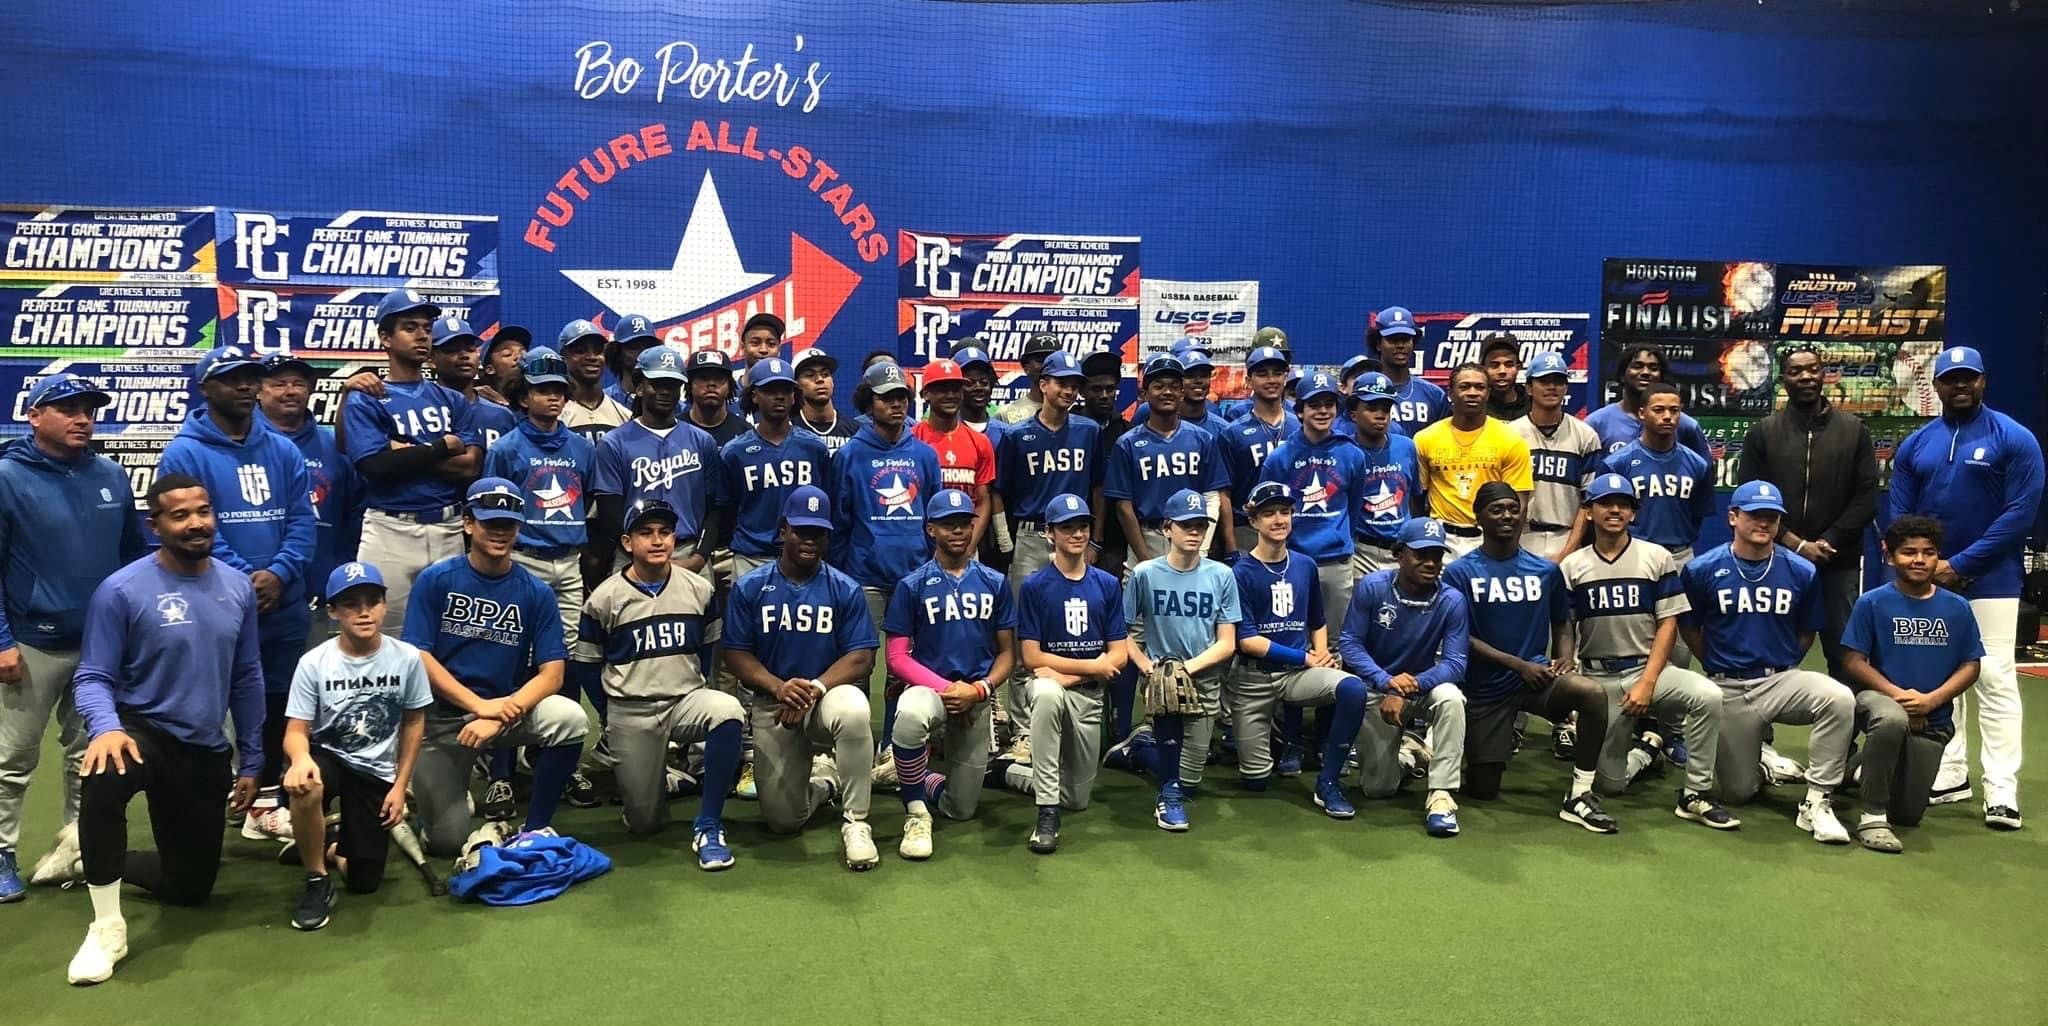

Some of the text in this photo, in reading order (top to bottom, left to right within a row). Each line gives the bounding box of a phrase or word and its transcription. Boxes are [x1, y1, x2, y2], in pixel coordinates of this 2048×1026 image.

[573, 34, 831, 113] Bo Porter's
[523, 120, 890, 263] FUTURE ALL-STARS
[16, 222, 188, 238] PERFECT GAME TOURNAMENT
[312, 228, 470, 246] PERFECT GAME TOURNAMENT
[5, 237, 184, 270] CHAMPIONS
[302, 243, 468, 277] CHAMPIONS
[1016, 252, 1050, 264] YOUTH
[1053, 253, 1123, 266] TOURNAMENT
[597, 278, 656, 291] EST. 1998
[971, 263, 1114, 295] CHAMPIONS
[1626, 264, 1697, 281] HOUSTON
[1788, 280, 1857, 291] HOUSTON
[21, 300, 190, 313] PERFECT GAME TOURNAMENT
[1161, 292, 1240, 301] USSSA BASEBALL
[314, 304, 363, 318] PERFECT
[1606, 303, 1734, 331] FINALIST
[1779, 307, 1939, 335] FINALIST
[10, 314, 189, 346] CHAMPIONS
[1015, 320, 1049, 332] YOUTH
[1051, 321, 1121, 334] TOURNAMENT
[1147, 345, 1170, 353] WORL
[115, 377, 191, 390] TOURNAMENT
[12, 391, 190, 422] CPIONS
[1390, 401, 1429, 422] ASB
[631, 449, 702, 493] Royals
[744, 460, 812, 492] FASB
[1026, 448, 1086, 476] FASB
[1631, 474, 1695, 500] FASB
[1471, 575, 1542, 603] FASB
[1588, 585, 1640, 609] FASB
[1717, 587, 1792, 615] FASB
[442, 592, 524, 633] BPA
[924, 593, 994, 625] FASB
[1152, 589, 1214, 619] FASB
[761, 603, 833, 634] FASB
[1892, 617, 1949, 637] BPA
[440, 620, 521, 647] BASEBALL
[632, 622, 686, 652] FASB
